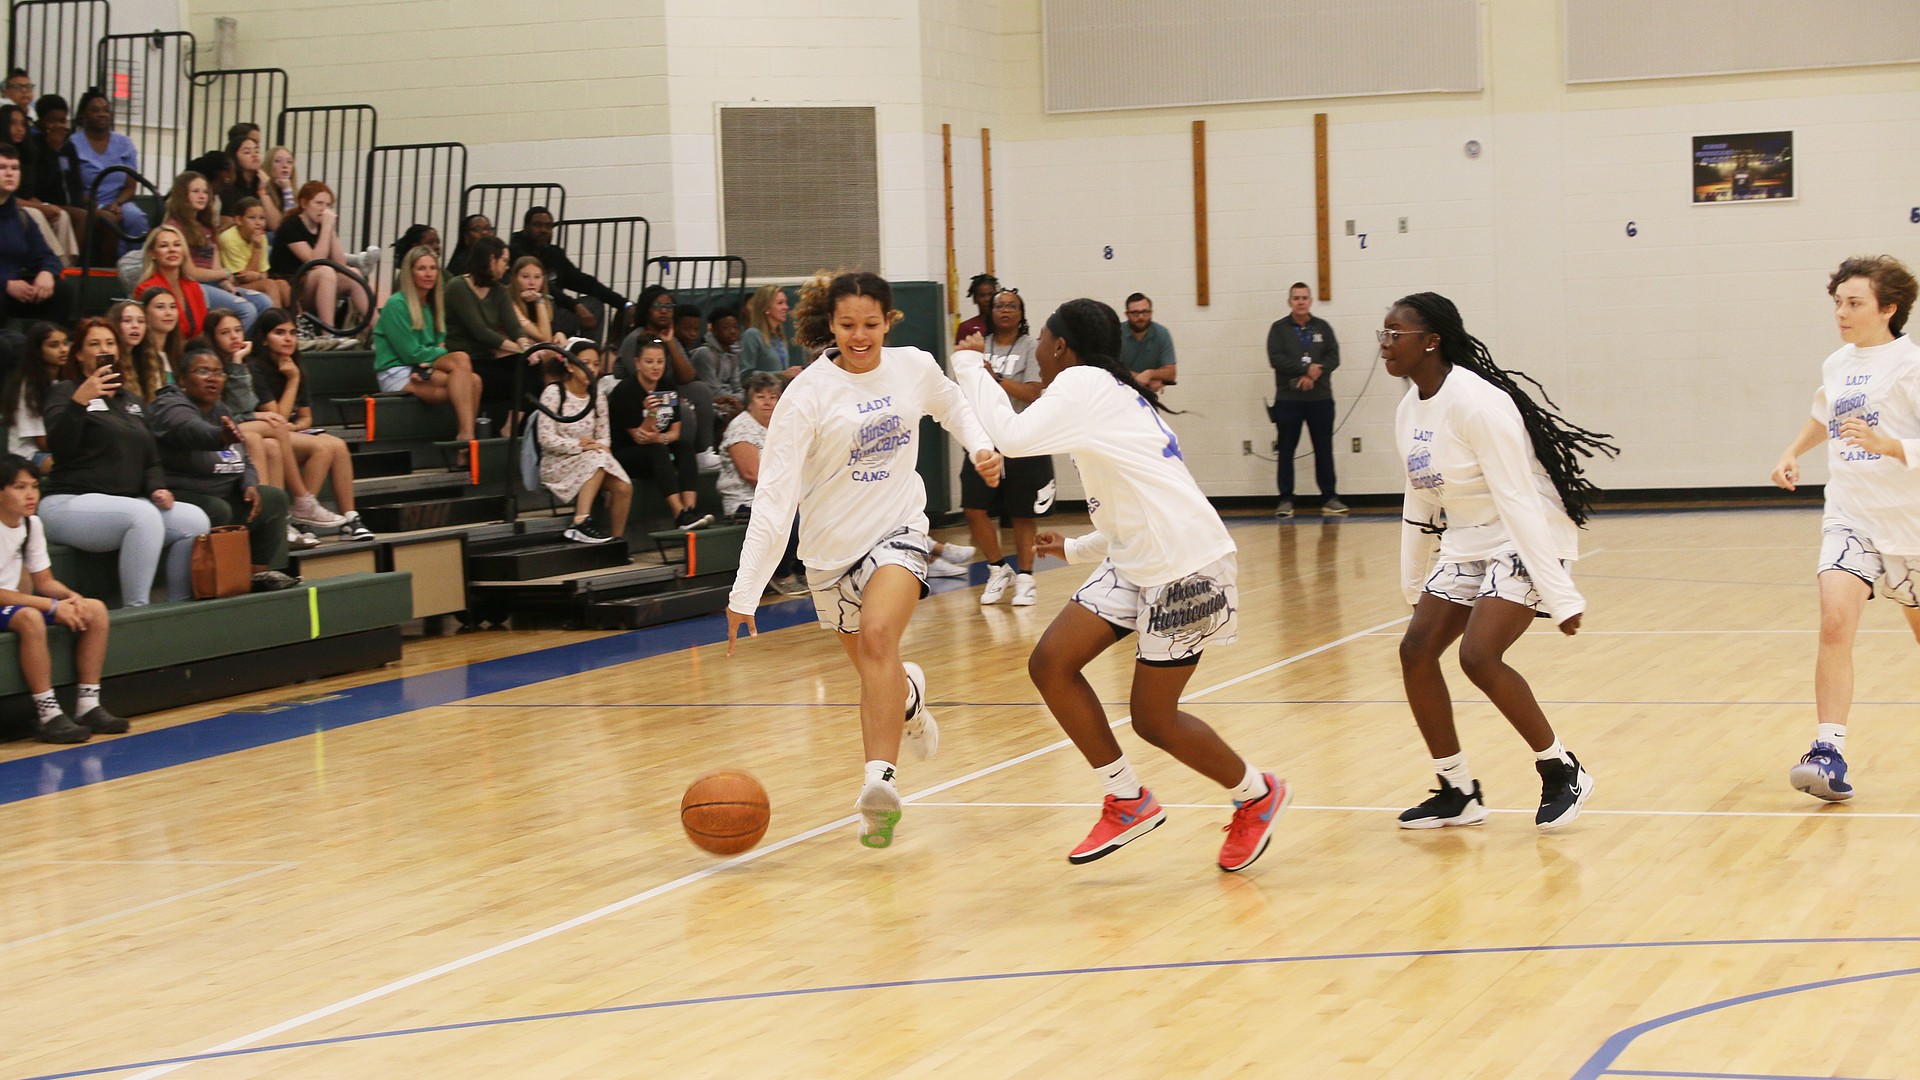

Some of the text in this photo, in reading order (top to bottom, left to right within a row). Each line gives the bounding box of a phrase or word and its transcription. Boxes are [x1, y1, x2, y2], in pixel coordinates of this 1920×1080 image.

[1626, 221, 1637, 237] 6
[1358, 233, 1367, 249] 7
[1103, 245, 1113, 260] 8
[1845, 374, 1872, 386] LADY
[857, 396, 892, 414] LADY
[1835, 393, 1866, 417] Hinson
[860, 415, 900, 448] Hinson
[1413, 428, 1433, 442] LADY
[1165, 579, 1213, 608] Hinson
[1146, 589, 1228, 634] Hurricanes
